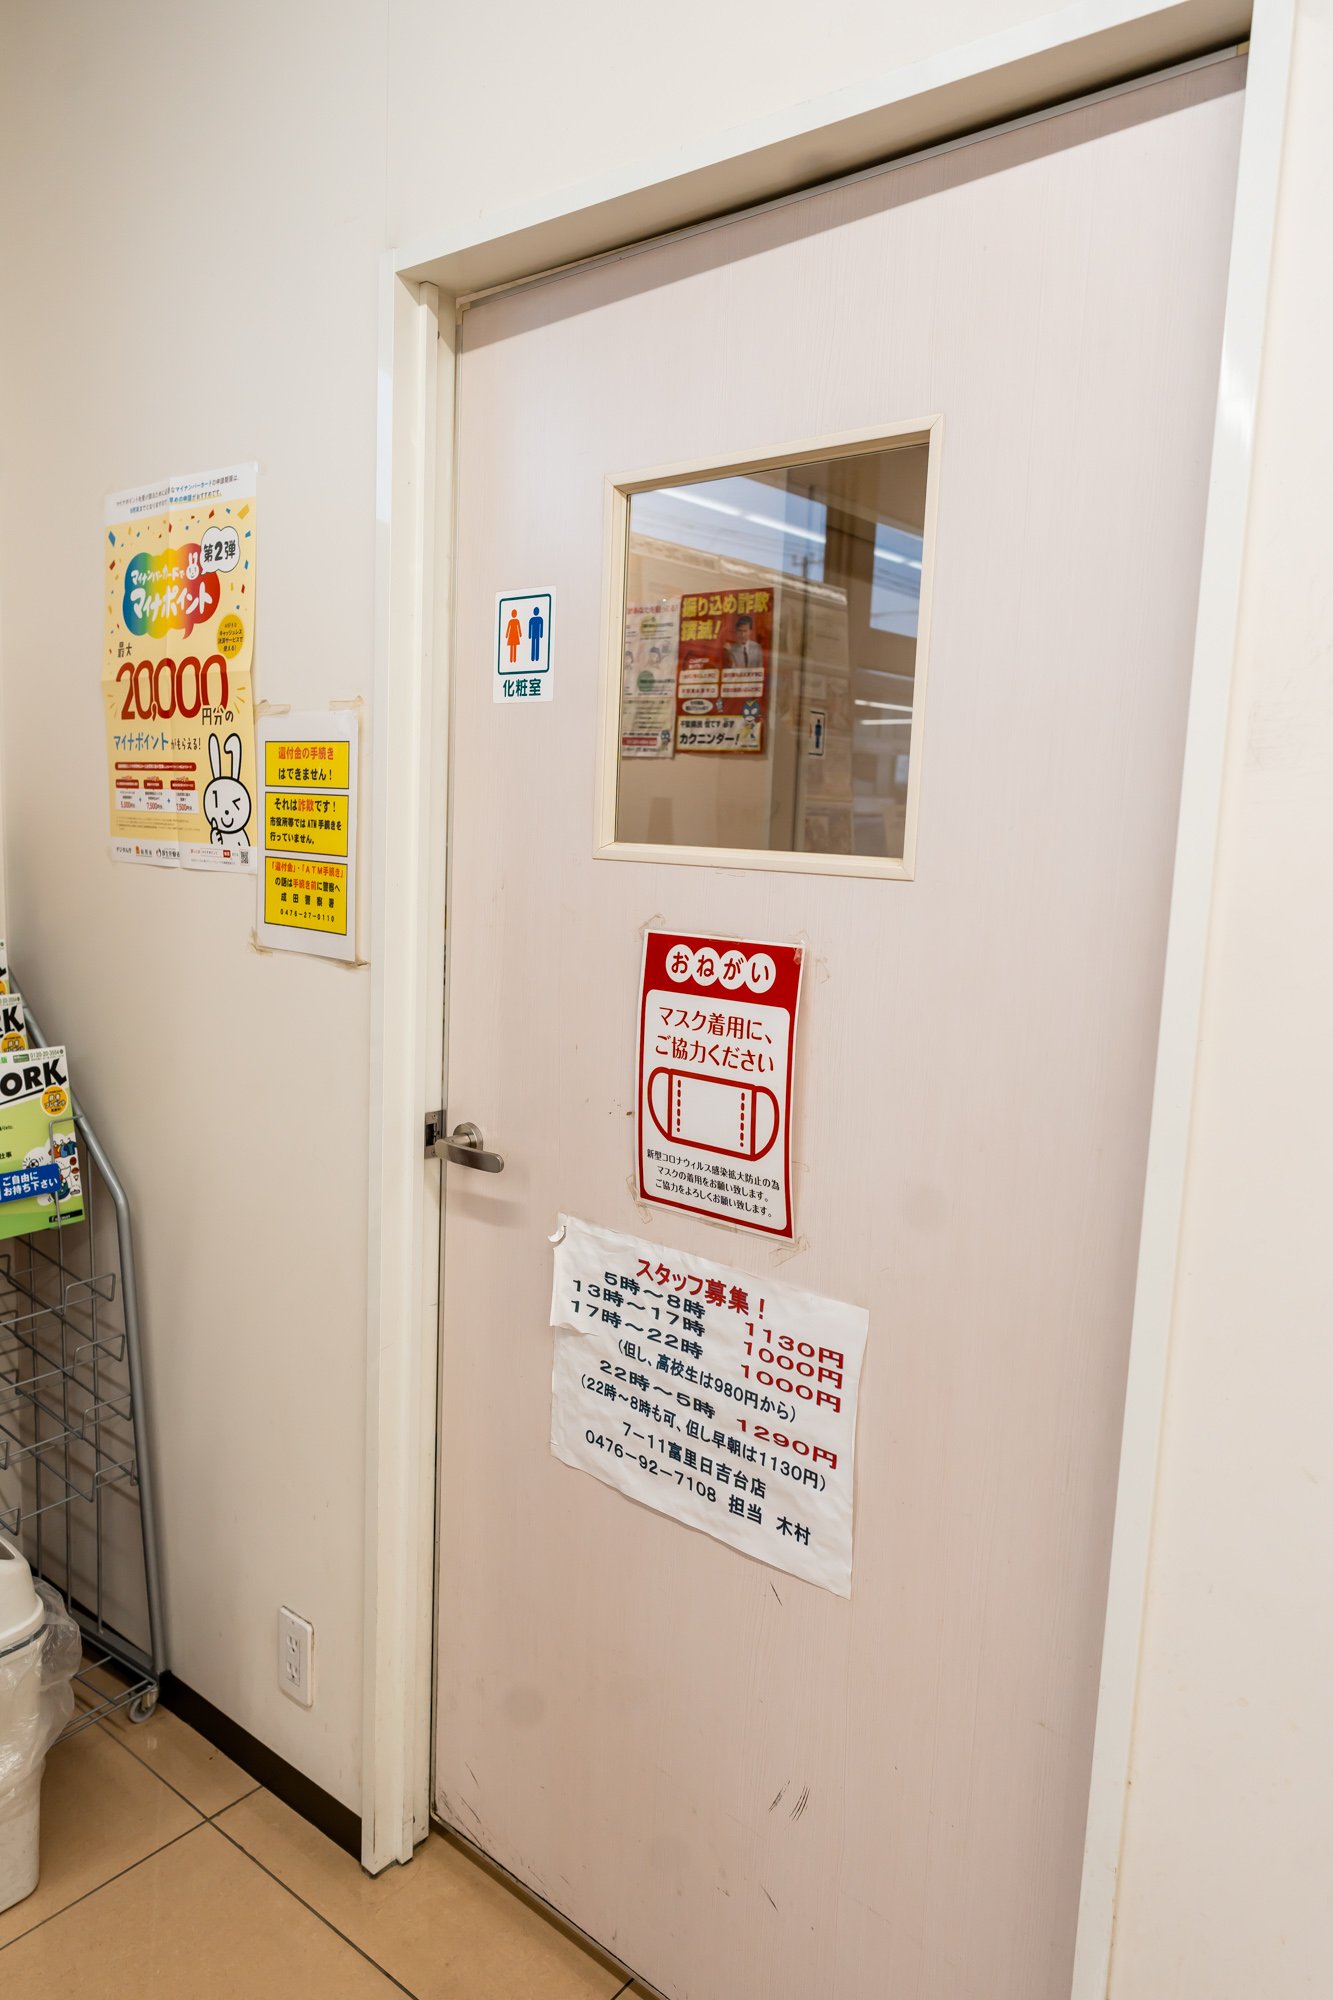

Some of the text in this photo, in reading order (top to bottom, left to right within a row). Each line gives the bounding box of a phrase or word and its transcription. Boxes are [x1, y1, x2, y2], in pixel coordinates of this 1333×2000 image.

[203, 540, 236, 563] 第2弾
[131, 564, 185, 586] マイナンバーカードで
[130, 581, 213, 622] マイナポイント
[681, 591, 770, 617] 振り込め詐欺
[680, 620, 722, 641] 撲滅!
[117, 641, 133, 658] 最大
[116, 654, 229, 721] 20,000
[502, 677, 542, 698] 化粧室
[202, 705, 234, 726] 円分の
[113, 732, 201, 752] マイナポイント がもらえる!
[679, 733, 740, 745] カクニンダー!
[278, 746, 334, 761] 還付金の手続き
[278, 767, 332, 781] はできません！
[274, 798, 336, 813] それは詐欺です！
[317, 819, 342, 831] 手続きを
[269, 831, 315, 844] 行っていません。
[274, 877, 341, 893] の話は手続き前に警察へ
[671, 951, 770, 982] おねがい
[658, 1006, 774, 1045] マスク着用に、
[655, 1034, 775, 1073] ご協力ください
[2, 1171, 39, 1187] ご自由に
[646, 1147, 780, 1192] 新型コロナウィルス感染拡大防止の為
[3, 1178, 58, 1197] お持ち下さい
[656, 1164, 770, 1203] マスクの着用をお願い致します。
[654, 1178, 773, 1218] ご協力をよろしくお願い致します。
[635, 1257, 767, 1320] スタッフ募集！
[604, 1271, 845, 1370] 5時～8時 1130円
[572, 1279, 843, 1390] 13時～17時 1000円
[570, 1300, 842, 1413] 17時～22時 1000円
[599, 1360, 838, 1470] 22時～5時 1290円
[728, 1494, 763, 1525] 担当
[775, 1515, 812, 1546] 木村
